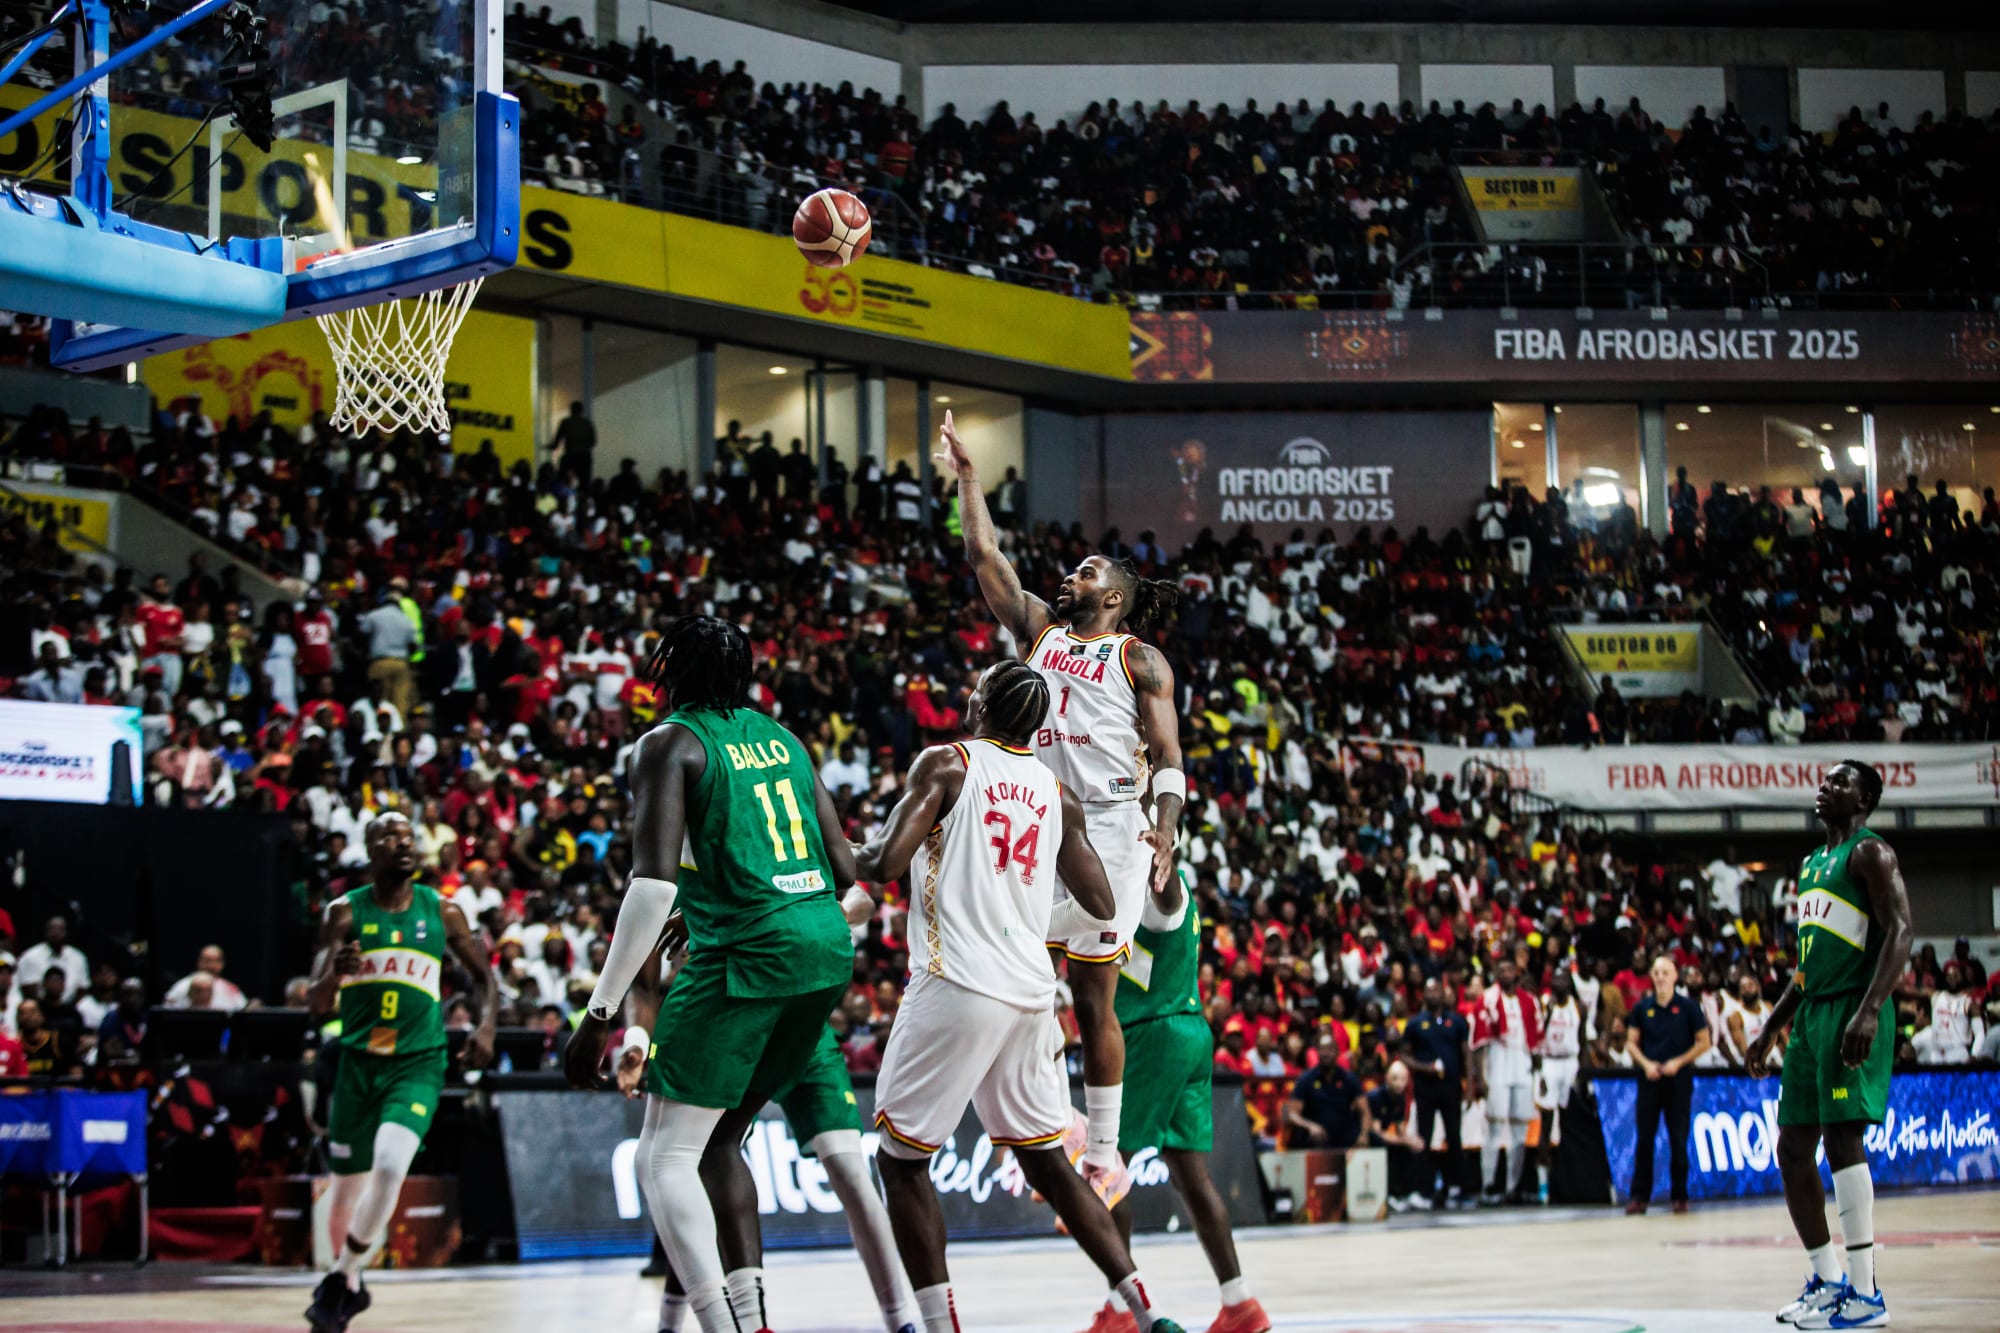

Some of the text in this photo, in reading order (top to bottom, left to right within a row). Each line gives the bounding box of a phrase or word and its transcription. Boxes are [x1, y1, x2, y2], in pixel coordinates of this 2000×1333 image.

[1485, 179, 1555, 194] SECTOR 11
[1495, 329, 1860, 360] FIBA AFROBASKET 2025
[1219, 466, 1393, 496] AFROBASKET
[1220, 499, 1394, 523] ANGOLA 2025
[1041, 649, 1105, 684] ANGOLA
[1056, 686, 1070, 719] 1
[725, 739, 790, 771] BALLO
[1607, 763, 1667, 790] FIBA
[1677, 762, 1829, 789] AFROBASKE
[984, 782, 1047, 821] KOKILA
[753, 777, 809, 862] 11
[983, 809, 1040, 887] 34
[778, 877, 808, 890] PMU
[380, 991, 399, 1019] 9
[1862, 1107, 1897, 1160] eel
[1897, 1114, 1929, 1156] the
